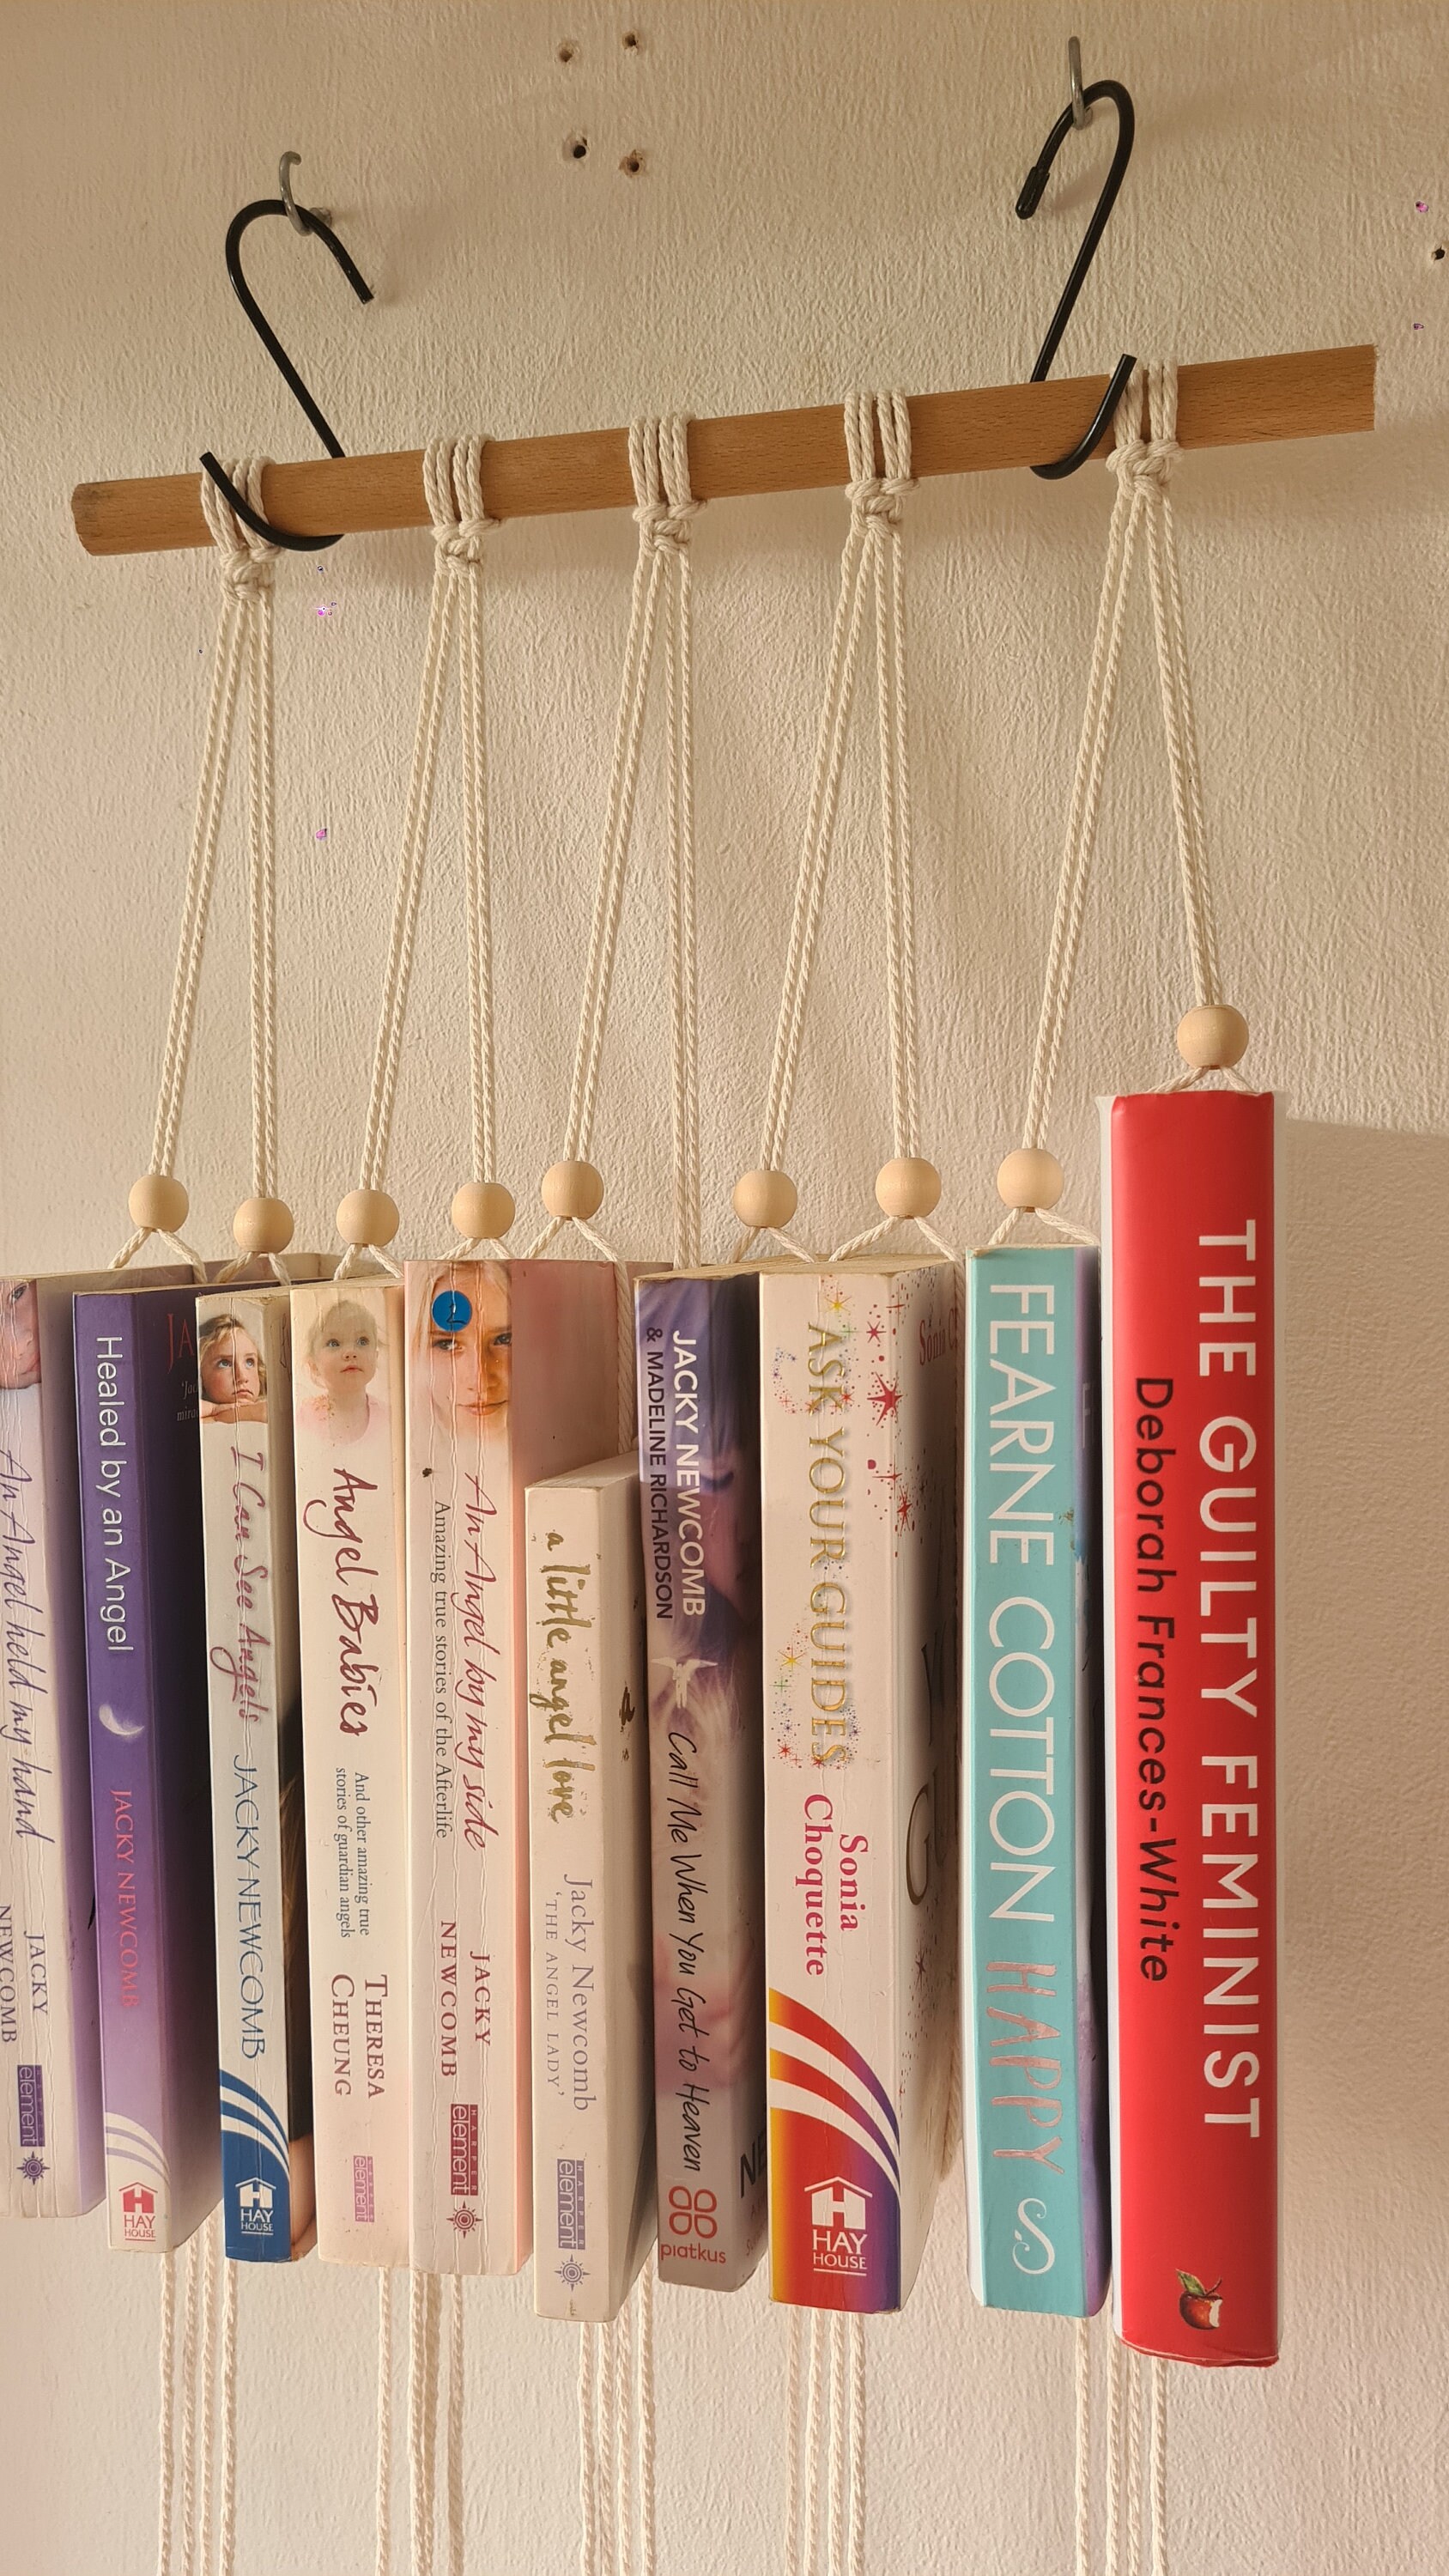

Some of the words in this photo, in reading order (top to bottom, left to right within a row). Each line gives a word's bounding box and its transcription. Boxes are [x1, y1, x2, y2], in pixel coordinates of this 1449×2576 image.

[646, 1327, 663, 1343] &
[1198, 1219, 1256, 1377] THE
[95, 1335, 126, 1448] Healed
[673, 1329, 698, 1434] JACKY
[807, 1322, 845, 1416] ASK
[646, 1352, 667, 1465] MADELINE
[989, 1284, 1055, 1565] FEARNE
[0, 1449, 33, 1502] An
[94, 1460, 127, 1498] by
[231, 1445, 264, 1472] I
[1135, 1376, 1177, 1592] Deborah
[101, 1509, 124, 1546] an
[232, 1481, 265, 1544] Can
[302, 1467, 379, 1585] Angel
[464, 1473, 499, 1533] An
[676, 1444, 706, 1617] NEWCOMB
[809, 1426, 847, 1570] YOUR
[0, 1510, 43, 1613] Angel
[430, 1500, 450, 1583] Amazing
[546, 1532, 564, 1552] a
[650, 1473, 673, 1619] RICHARDSON
[1199, 1415, 1258, 1718] GUILTY
[100, 1558, 134, 1653] Angel
[233, 1554, 267, 1613] See
[434, 1590, 446, 1627] true
[452, 1540, 500, 1656] Angel
[543, 1564, 592, 1648] little
[7, 1618, 48, 1694] held
[209, 1621, 271, 1723] Angels
[331, 1592, 379, 1737] Babies
[434, 1633, 448, 1694] stories
[455, 1659, 498, 1706] by
[809, 1582, 848, 1766] GUIDES
[0, 1701, 33, 1744] my
[435, 1702, 452, 1724] of
[453, 1712, 487, 1769] my
[529, 1658, 597, 1746] angel
[435, 1727, 452, 1757] the
[668, 1730, 699, 1788] Call
[988, 1596, 1055, 1922] COTTON
[12, 1756, 55, 1844] hand
[233, 1754, 260, 1878] JACKY
[336, 1767, 350, 1811] stories
[336, 1815, 352, 1832] of
[355, 1771, 370, 1801] And
[355, 1805, 371, 1843] other
[435, 1763, 452, 1838] Afterlife
[462, 1773, 500, 1850] side
[543, 1759, 597, 1824] love
[667, 1797, 702, 1844] Me
[1137, 1614, 1179, 1981] Frances-White
[109, 1789, 134, 1862] JACKY
[333, 1833, 353, 1893] guardian
[355, 1847, 372, 1904] amazing
[564, 1874, 593, 1954] Jacky
[670, 1851, 708, 1924] When
[796, 1793, 834, 1976] Choquette
[839, 1833, 868, 1932] Sonia
[117, 1873, 140, 2008] NEWCOMB
[336, 1897, 355, 1938] angels
[358, 1907, 370, 1936] true
[670, 1931, 704, 1977] You
[1202, 1755, 1259, 2138] FEMINIST
[0, 1905, 17, 2043] NEWCOMB
[23, 1930, 48, 2014] JACKY
[234, 1877, 265, 2060] NEWCOMB
[441, 1921, 457, 2078] NEWCOMB
[470, 1951, 491, 2045] JACKY
[546, 1953, 558, 2021] ANGEL
[330, 1974, 355, 2095] CHEUNG
[365, 1974, 387, 2099] THERESA
[573, 1965, 597, 2111] Newcomb
[672, 1985, 710, 2038] Get
[677, 2045, 710, 2073] to
[985, 1960, 1064, 2174] HAPPY
[19, 2066, 38, 2145] element
[676, 2082, 710, 2172] Heaven
[355, 2156, 367, 2221] element
[453, 2105, 469, 2195] element
[124, 2214, 155, 2229] HAY
[124, 2228, 155, 2239] HOUSE
[241, 2208, 273, 2222] HAY
[241, 2221, 273, 2233] HOUSE
[559, 2161, 575, 2249] element
[812, 2229, 868, 2253] HAY
[660, 2242, 726, 2264] piatkus
[812, 2251, 867, 2269] HOUSE
